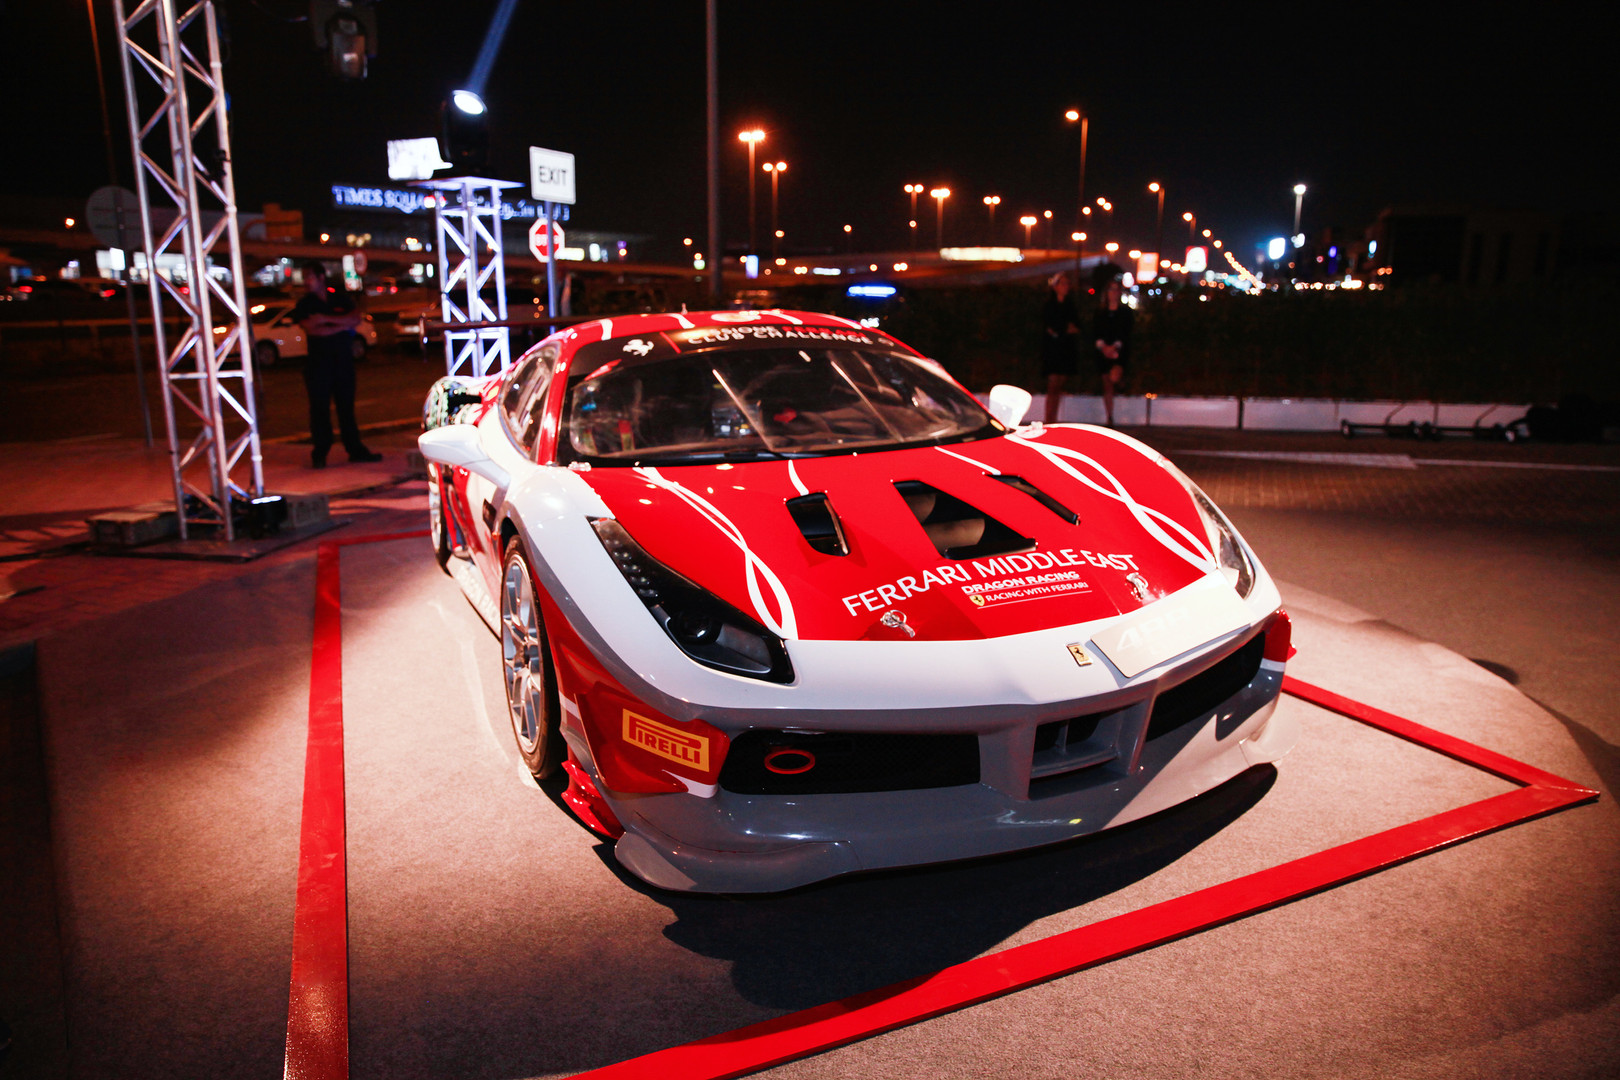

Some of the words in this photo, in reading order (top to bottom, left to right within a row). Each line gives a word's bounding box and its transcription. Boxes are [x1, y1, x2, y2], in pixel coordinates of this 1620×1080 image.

[538, 165, 567, 186] EXIT
[842, 563, 972, 617] FERRARI
[971, 549, 1086, 579] MIDDLE
[1080, 549, 1139, 571] EAST
[961, 576, 1026, 595] DRAGON
[1026, 571, 1080, 585] RACING
[985, 589, 1025, 602] RACING
[1023, 586, 1051, 597] WITH
[1050, 581, 1089, 592] FERRARI
[628, 715, 702, 764] PIRELLI
